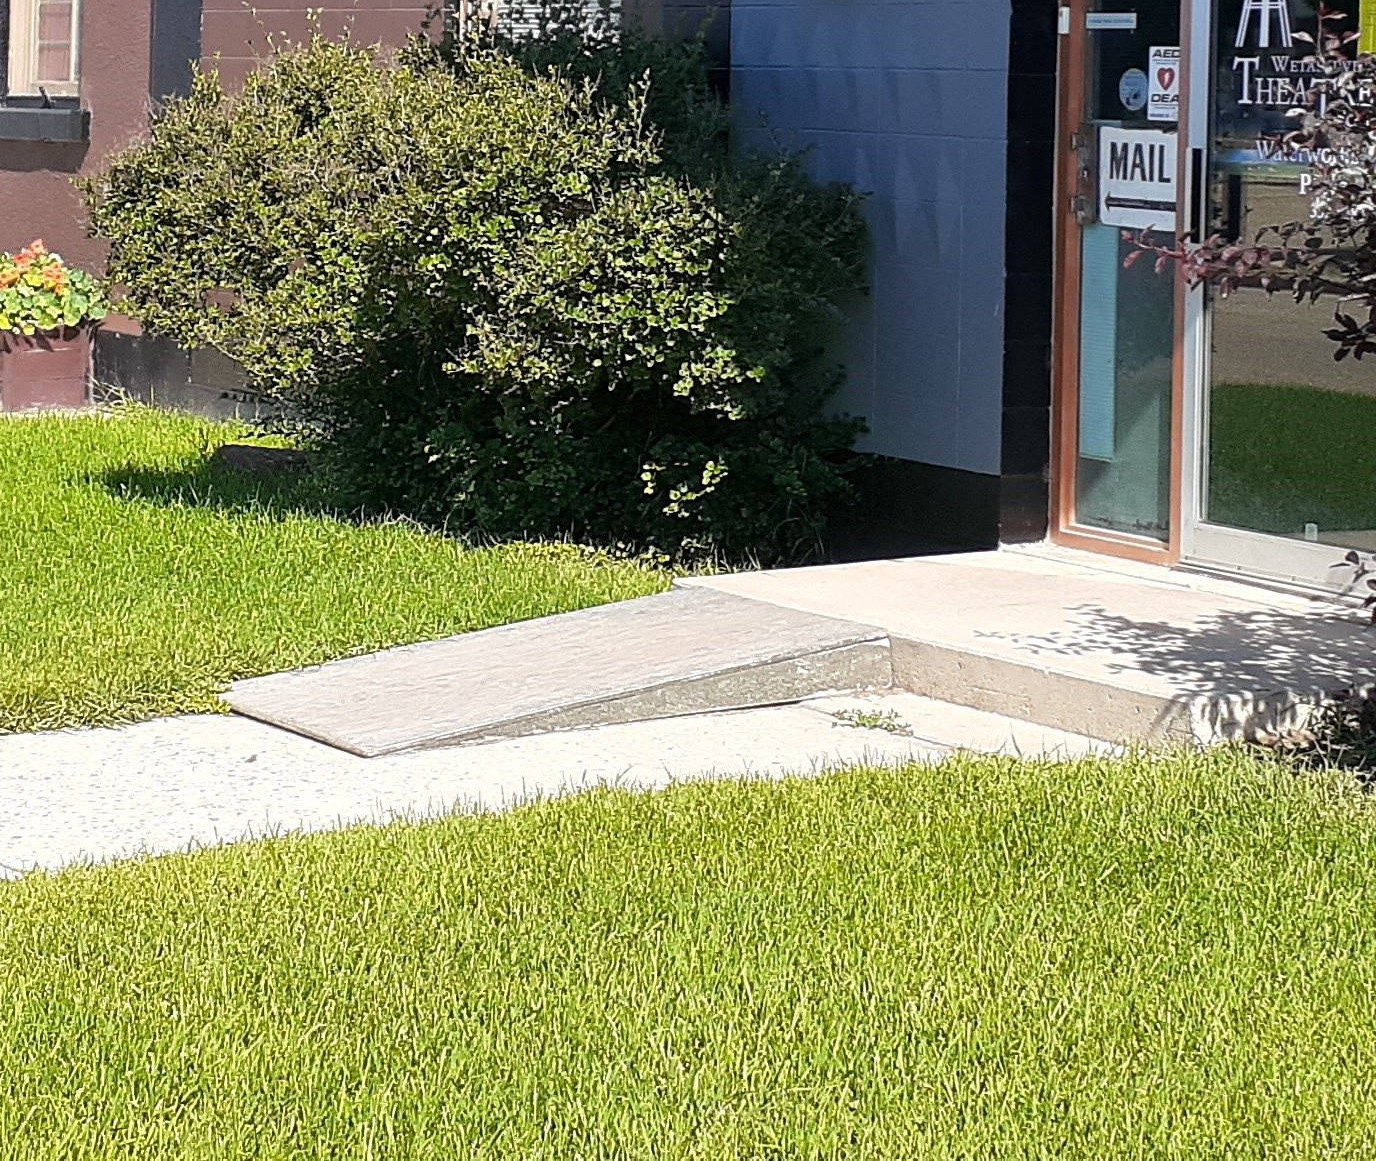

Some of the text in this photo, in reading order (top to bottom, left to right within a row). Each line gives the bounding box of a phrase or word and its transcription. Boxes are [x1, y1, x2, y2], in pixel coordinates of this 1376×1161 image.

[1152, 49, 1180, 58] AED
[1151, 94, 1179, 103] DEA
[1109, 141, 1171, 184] MAIL
